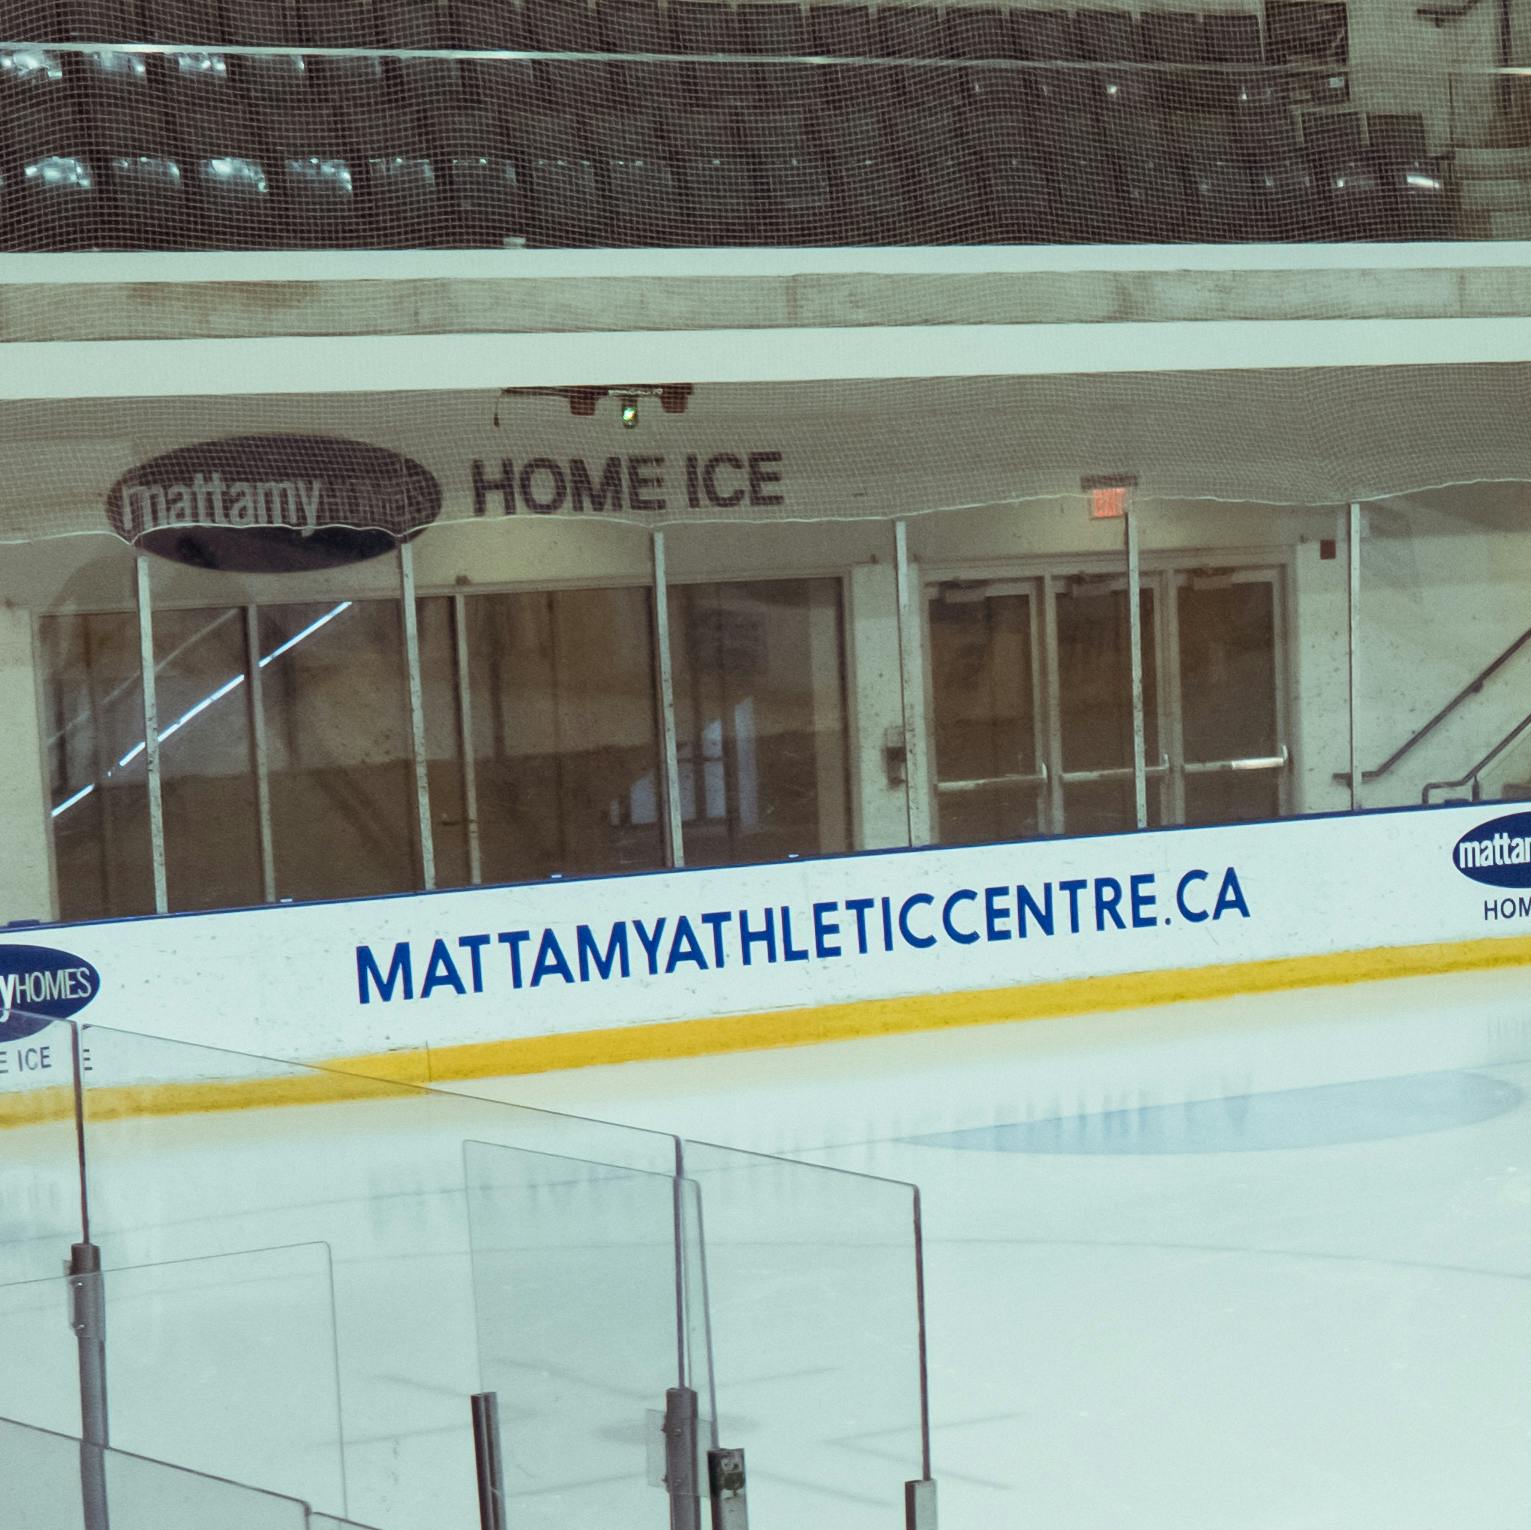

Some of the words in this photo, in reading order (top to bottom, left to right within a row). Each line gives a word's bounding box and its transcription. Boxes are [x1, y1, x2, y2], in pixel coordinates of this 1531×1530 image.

[471, 455, 667, 517] HOME
[686, 451, 785, 509] ICE
[355, 866, 1251, 1004] MATTAMYATHLETICCENTRE.CA
[17, 1046, 52, 1072] ICE
